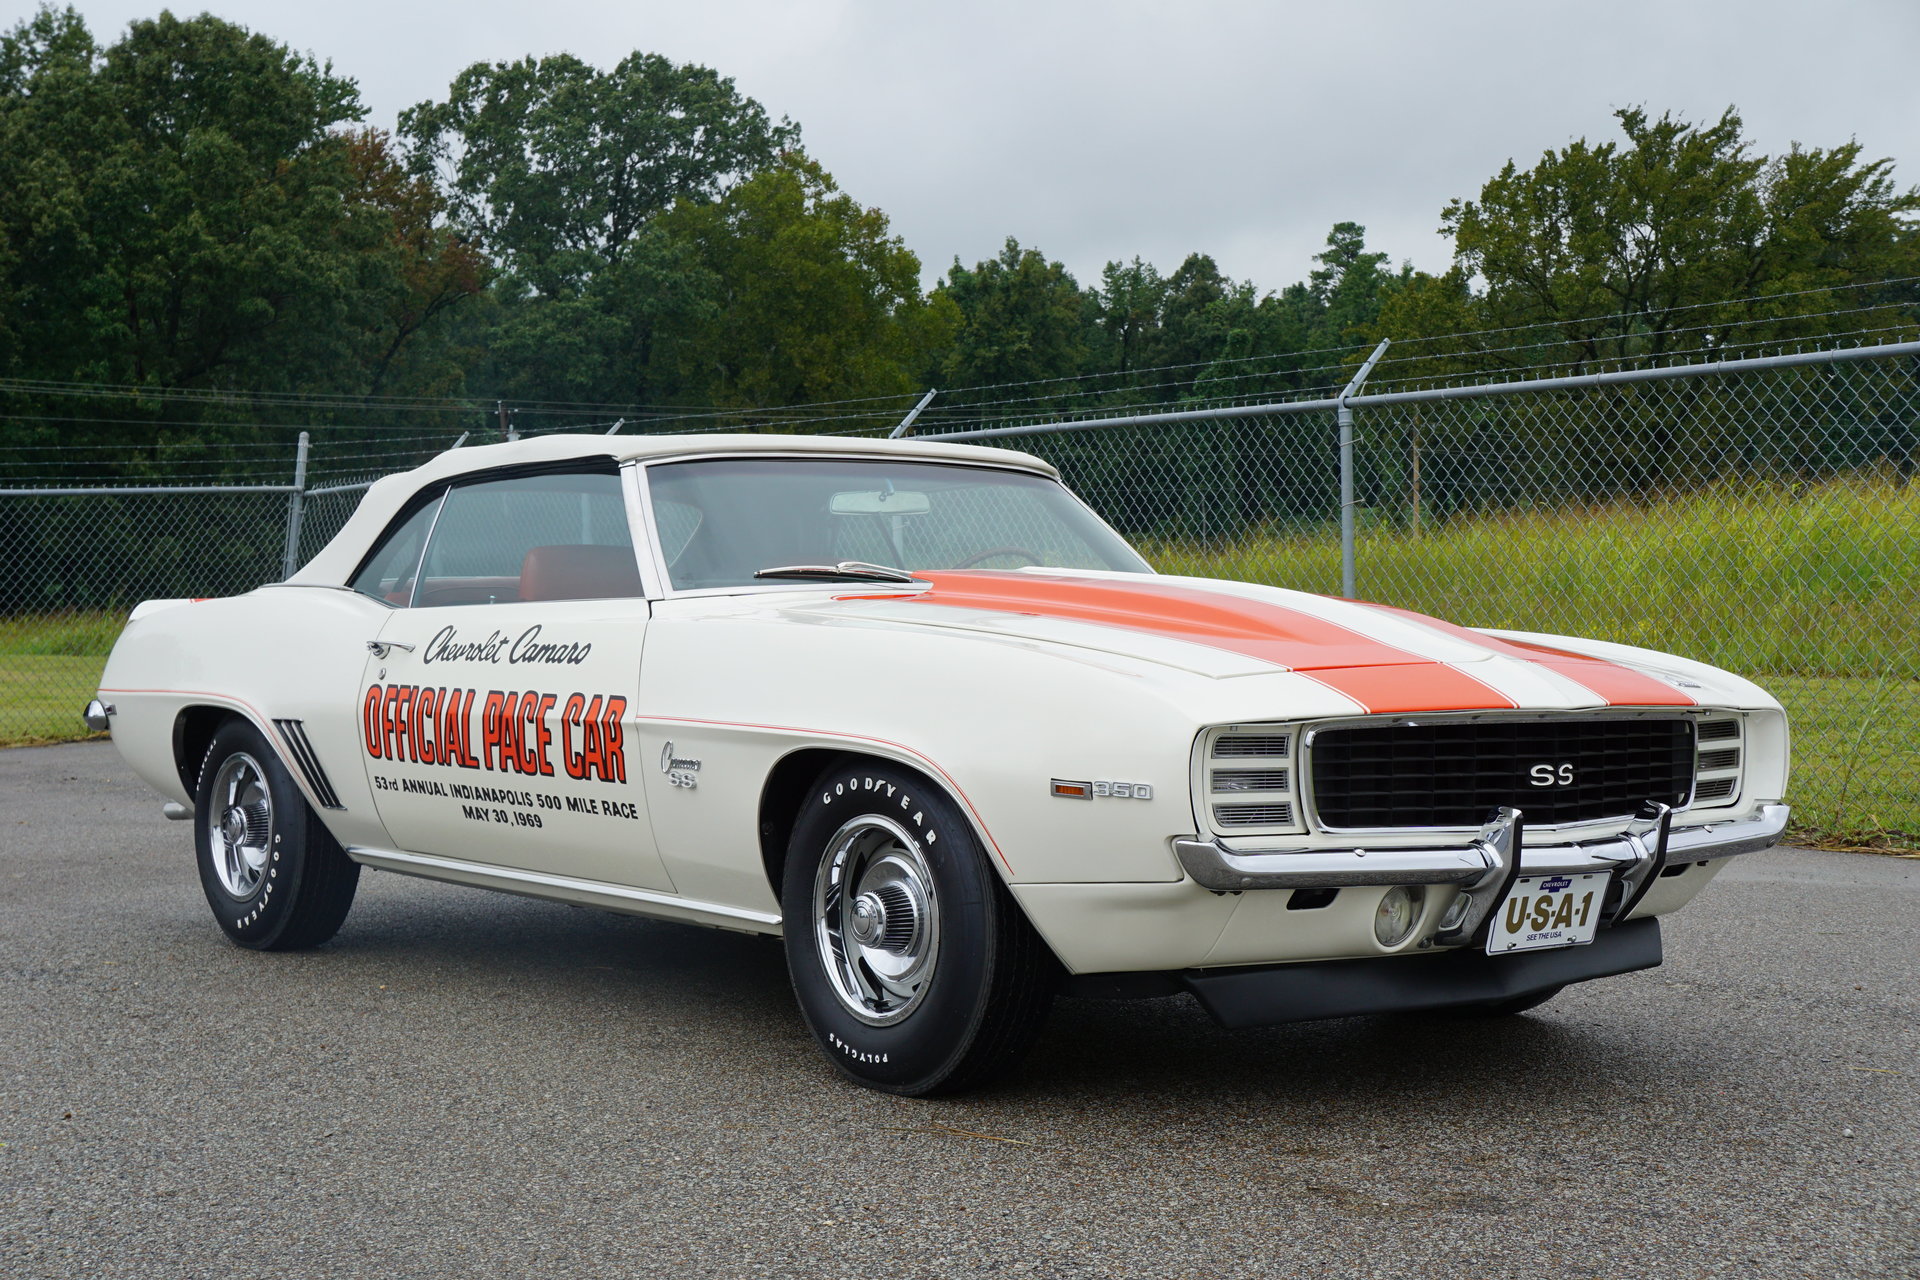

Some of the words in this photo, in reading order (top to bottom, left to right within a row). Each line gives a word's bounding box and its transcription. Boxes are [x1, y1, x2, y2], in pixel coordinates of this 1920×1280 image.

[423, 624, 510, 664] Chevrolet
[509, 624, 592, 664] Camaro
[363, 683, 479, 769] OFFICIAL
[482, 690, 557, 777] PACE
[561, 692, 627, 784] CAR
[668, 770, 697, 790] SS
[1094, 780, 1153, 800] 350
[1530, 763, 1573, 786] SS
[374, 776, 399, 791] 53rd
[402, 778, 448, 797] ANNUAL
[449, 783, 534, 807] INDIANAPOLIS
[536, 793, 562, 810] 500
[565, 796, 599, 815] MILE
[601, 800, 639, 820] RACE
[462, 805, 490, 822] MAY
[822, 777, 937, 846] GOODYEAR
[237, 834, 281, 929] GOODYEAR
[1526, 933, 1538, 942] SEE
[1538, 931, 1550, 940] THE
[1549, 931, 1562, 939] USA
